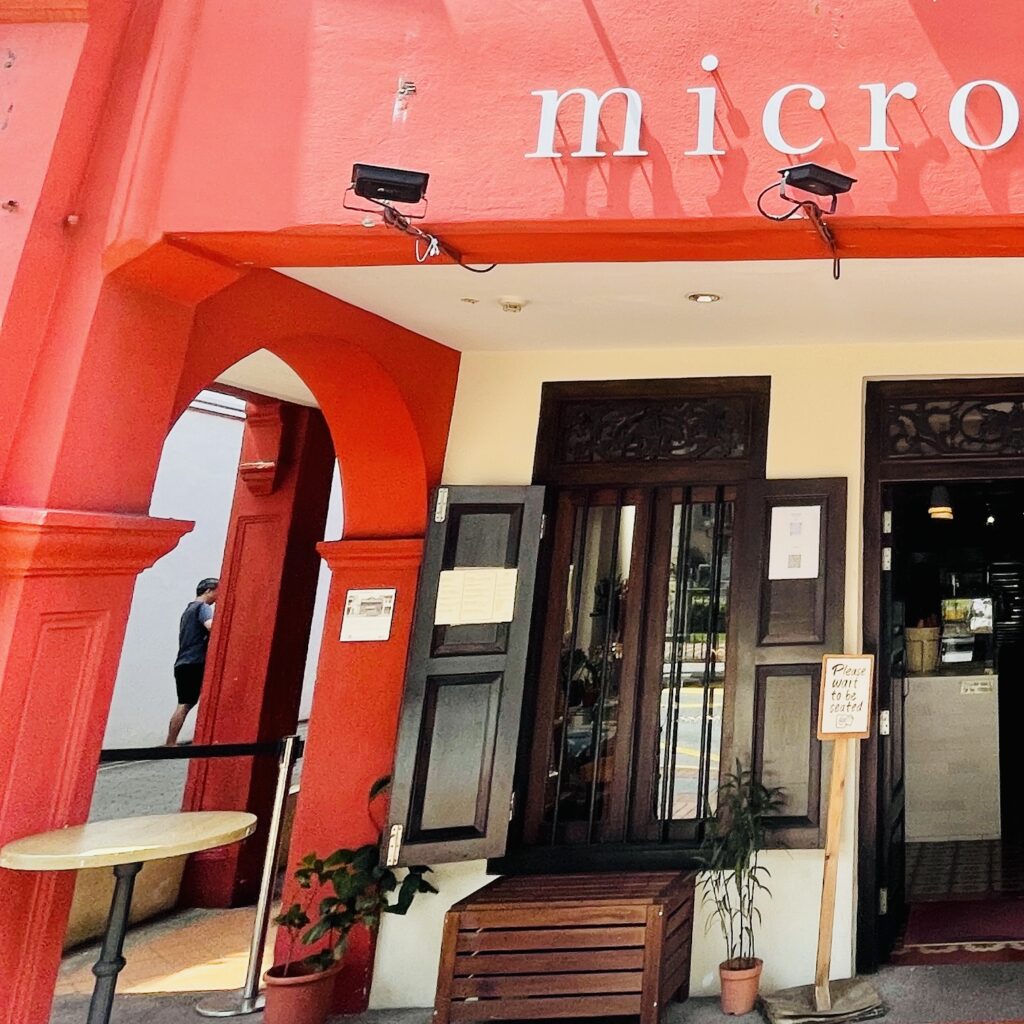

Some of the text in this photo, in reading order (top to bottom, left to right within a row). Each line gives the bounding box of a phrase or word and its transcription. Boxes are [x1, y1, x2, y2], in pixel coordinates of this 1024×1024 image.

[524, 54, 1021, 159] micro
[832, 663, 866, 676] Please
[832, 679, 858, 688] wait
[832, 689, 857, 701] to be
[830, 701, 863, 714] seated
